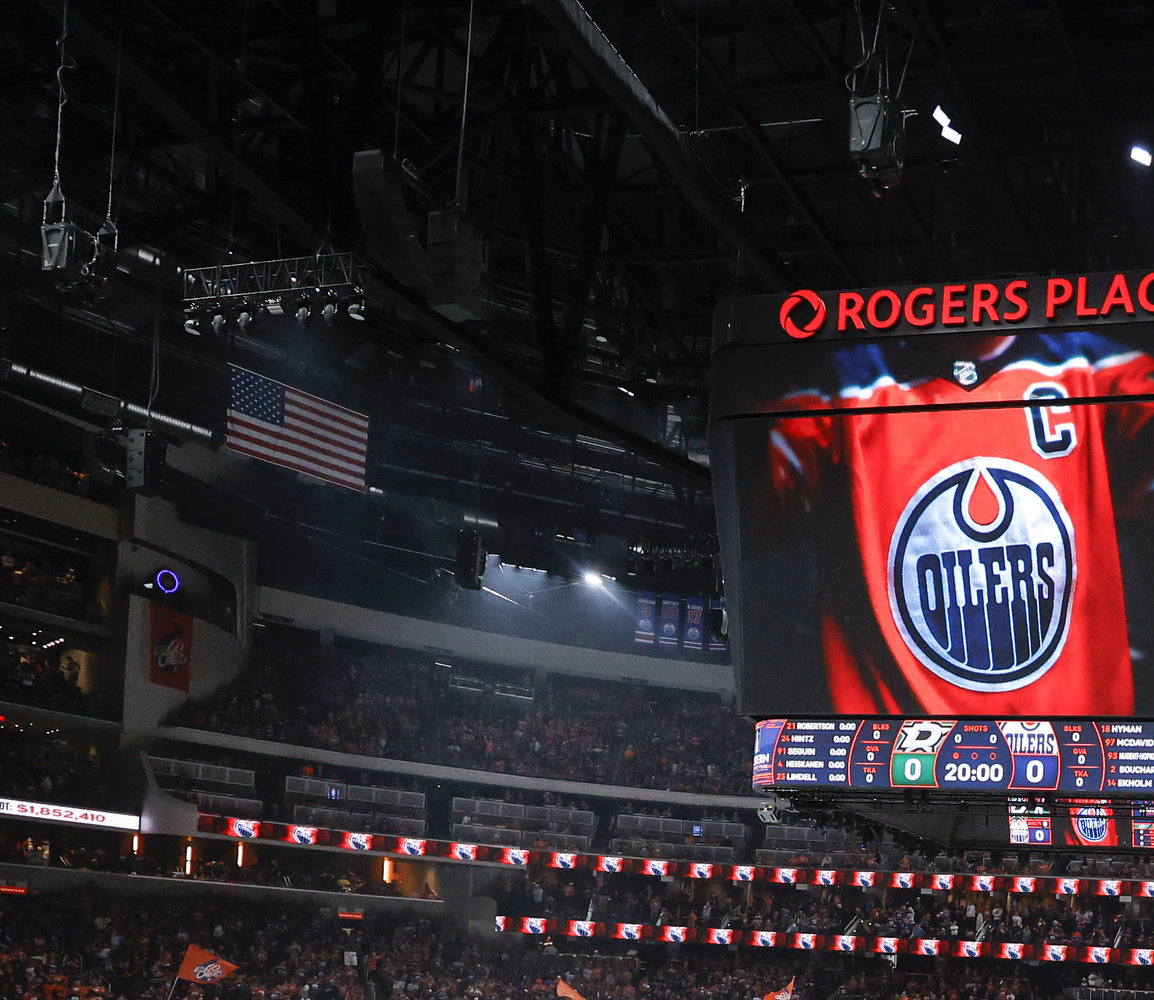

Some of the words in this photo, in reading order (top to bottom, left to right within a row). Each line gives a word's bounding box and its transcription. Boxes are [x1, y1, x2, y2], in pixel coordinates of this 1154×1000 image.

[838, 280, 1029, 331] ROGERS
[916, 541, 1056, 670] OILERS
[839, 723, 856, 731] 0:00
[1101, 725, 1110, 733] 18
[1111, 725, 1142, 733] HYMAN
[791, 735, 814, 743] HINTZ
[873, 731, 880, 739] 0
[955, 734, 962, 743] 0
[990, 734, 997, 744] 0
[1072, 732, 1080, 742] 0
[1005, 733, 1056, 754] OILERS
[1105, 739, 1116, 747] 97
[1116, 739, 1154, 747] MCDAVID
[787, 748, 816, 756] SEGUIN
[830, 748, 847, 756] 0:00
[867, 752, 874, 761] 0
[1107, 752, 1118, 760] 93
[1078, 755, 1086, 765] 0
[828, 761, 845, 769] 0:00
[904, 758, 922, 781] 0
[944, 763, 1004, 782] 20:00
[1026, 760, 1044, 783] 0
[786, 773, 817, 781] LINDELL
[866, 774, 873, 783] 0
[1075, 777, 1084, 787] 0
[1117, 780, 1152, 788] EKHOLM
[17, 804, 105, 823] $1,852,410
